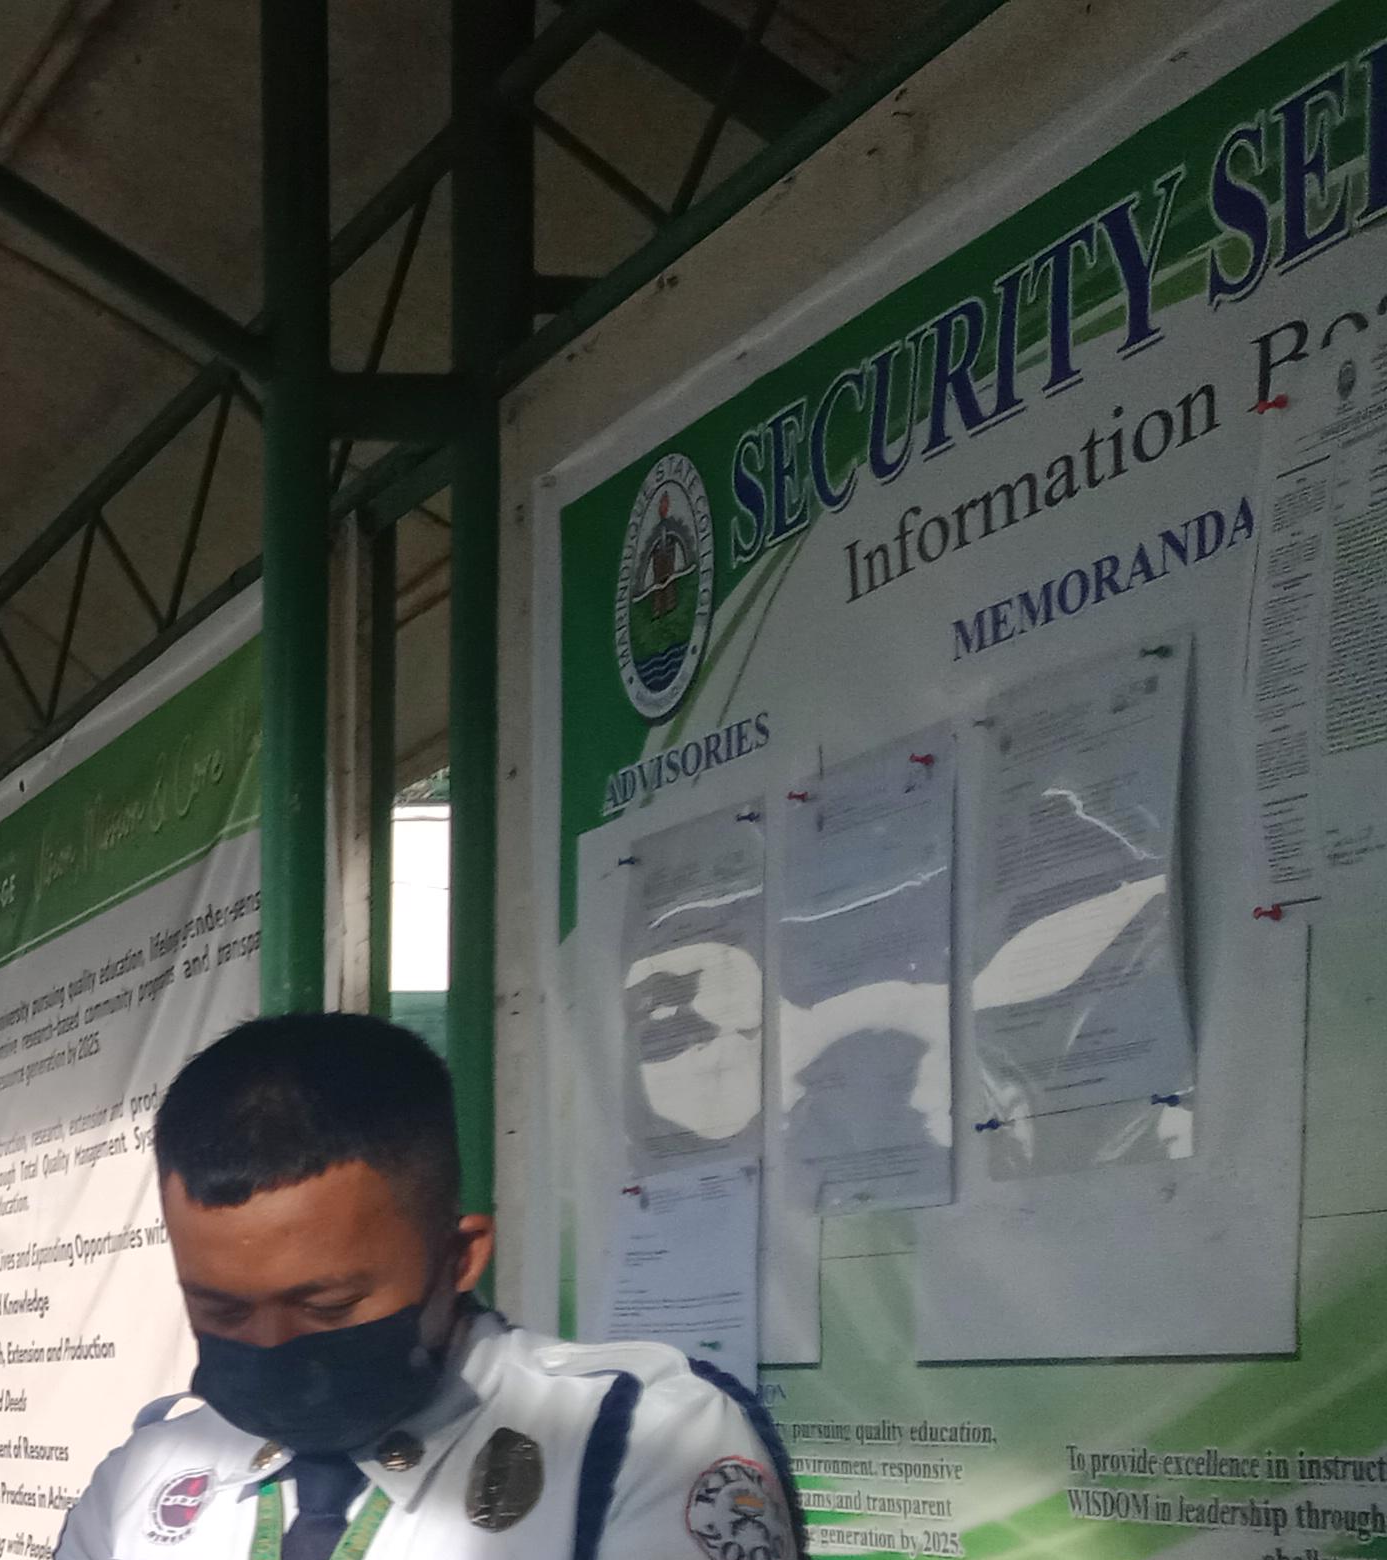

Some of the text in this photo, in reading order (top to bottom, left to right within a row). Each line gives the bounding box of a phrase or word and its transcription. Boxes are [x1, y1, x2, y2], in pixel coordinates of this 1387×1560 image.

[730, 163, 1187, 568] SECURITY
[843, 384, 1221, 603] Information
[950, 496, 1256, 661] MEMORANDA
[602, 711, 771, 814] ADVISORIES
[183, 944, 210, 979] and
[130, 1083, 165, 1122] prod
[3, 1288, 49, 1319] Knowledge
[46, 1337, 63, 1362] and
[64, 1334, 115, 1361] Production
[23, 1436, 69, 1461] Resources
[792, 1420, 851, 1446] pursuing
[855, 1418, 904, 1447] quality
[910, 1420, 998, 1447] education,
[881, 1457, 964, 1484] responsive
[1066, 1444, 1387, 1483] To provide excellence in instruct
[836, 1490, 862, 1511] and
[867, 1494, 953, 1520] transparent
[1067, 1489, 1387, 1543] WISDOM in leadership through
[821, 1526, 897, 1550] generation
[901, 1529, 919, 1558] by
[923, 1529, 964, 1556] 2025.
